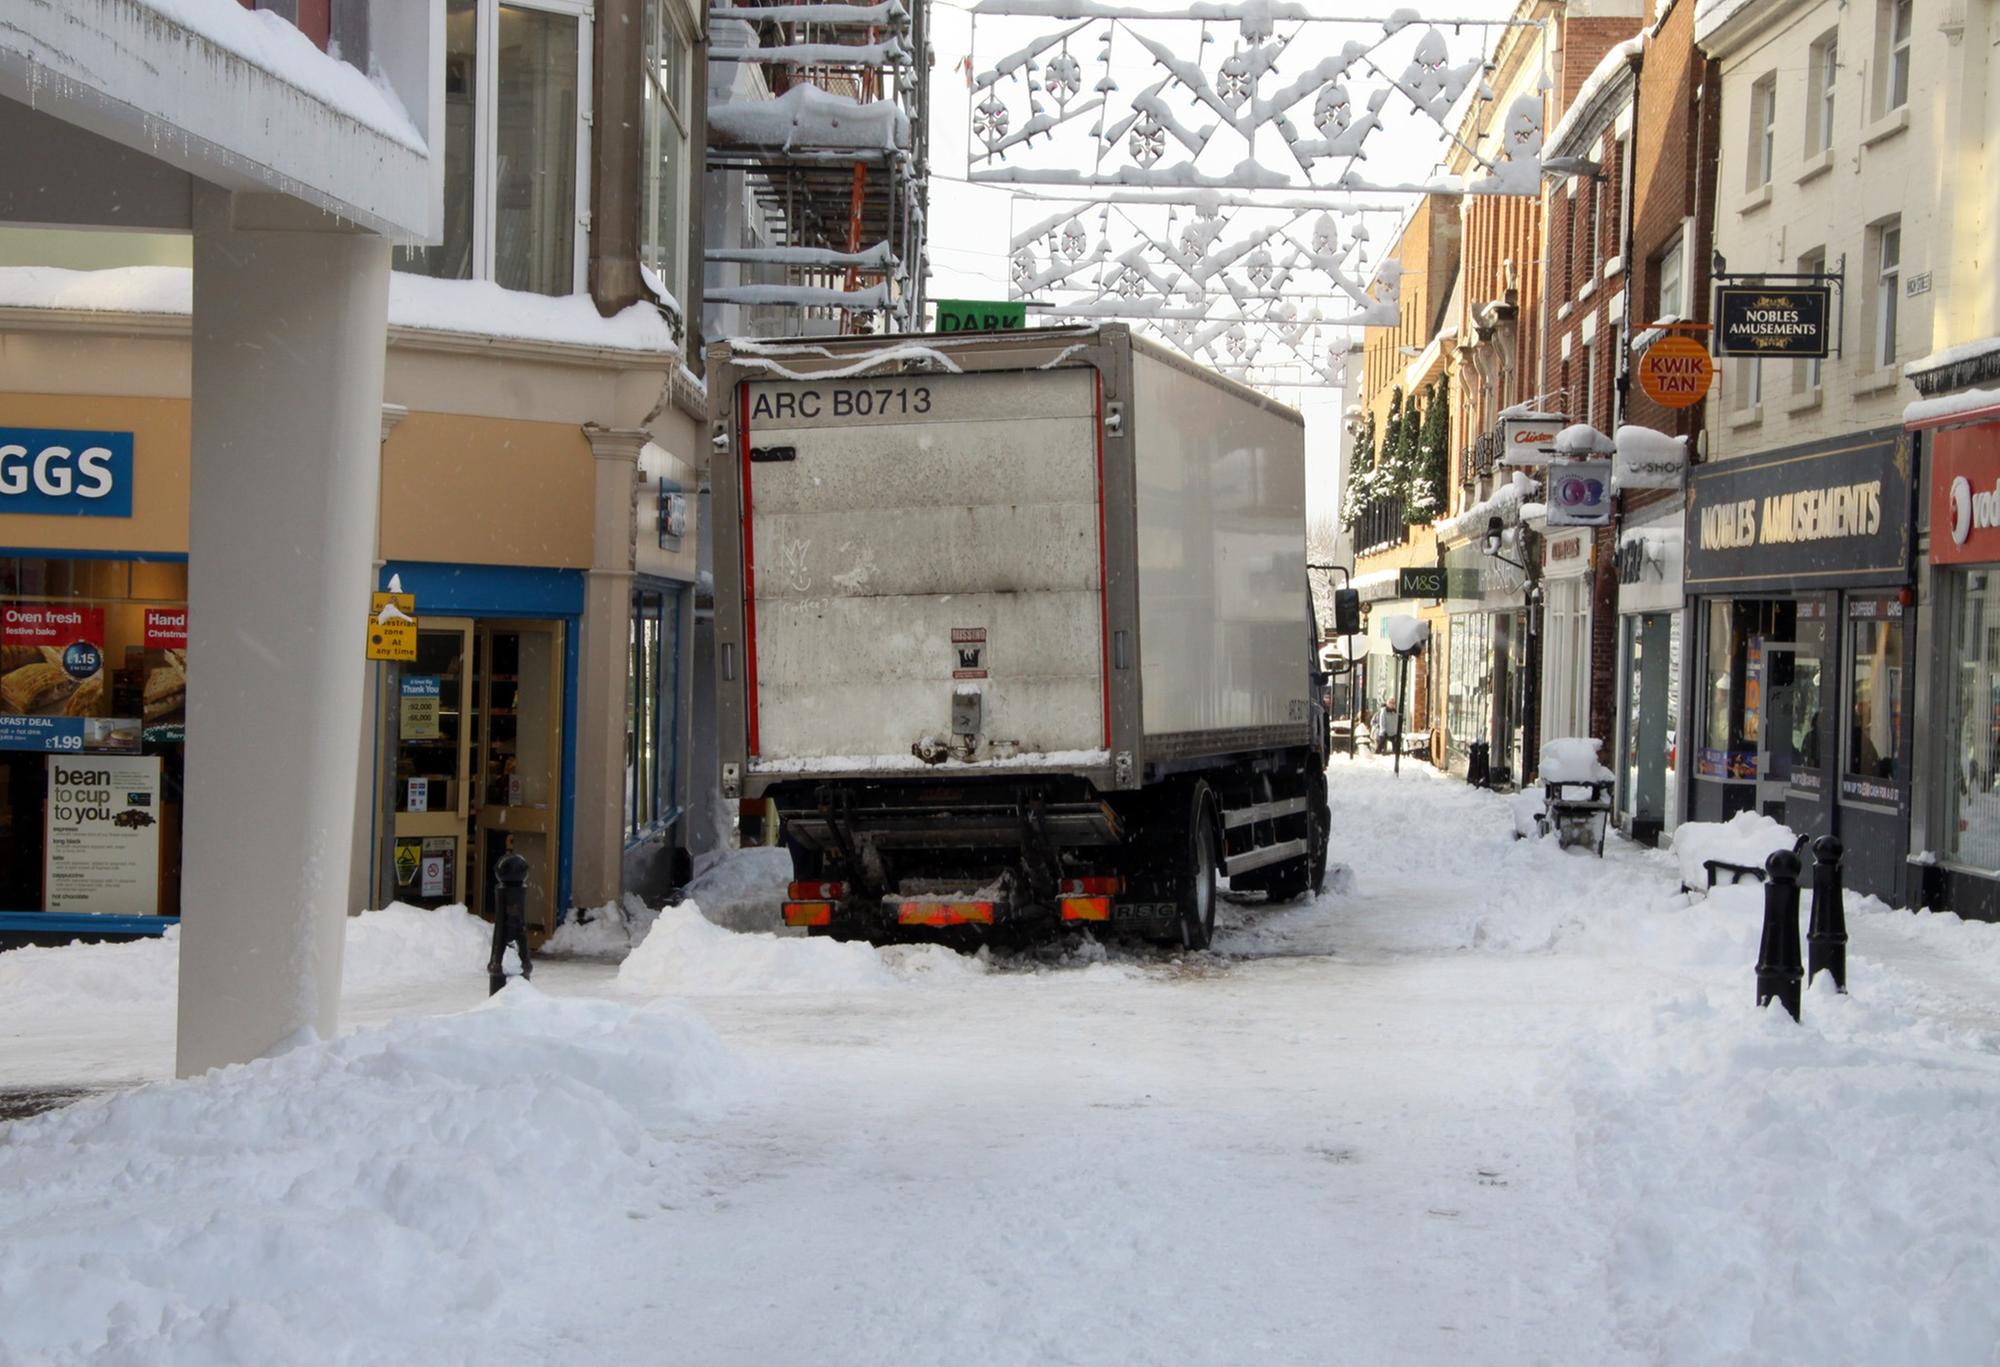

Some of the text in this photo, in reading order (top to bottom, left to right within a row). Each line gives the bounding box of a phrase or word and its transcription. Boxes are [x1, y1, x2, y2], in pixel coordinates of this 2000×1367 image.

[1746, 310, 1799, 323] NOBLES
[1729, 323, 1816, 335] AMUSEMENTS
[1650, 357, 1703, 376] KWIK
[1658, 375, 1696, 393] TAN
[752, 388, 931, 419] ARC B0713
[0, 444, 114, 499] GGS
[1701, 480, 1881, 550] NOBLES AMUSEMENTS
[1404, 574, 1441, 592] M&S
[6, 610, 82, 624] Oven fresh
[149, 613, 185, 626] Hand
[6, 627, 56, 636] festive bake
[67, 653, 95, 664] £1.15
[376, 648, 415, 656] any time
[403, 685, 440, 694] Thank You
[28, 718, 54, 727] DEAL
[45, 735, 83, 749] £1.99
[54, 765, 111, 786] bean
[55, 787, 72, 803] to
[75, 788, 111, 806] cup
[55, 806, 72, 821] to
